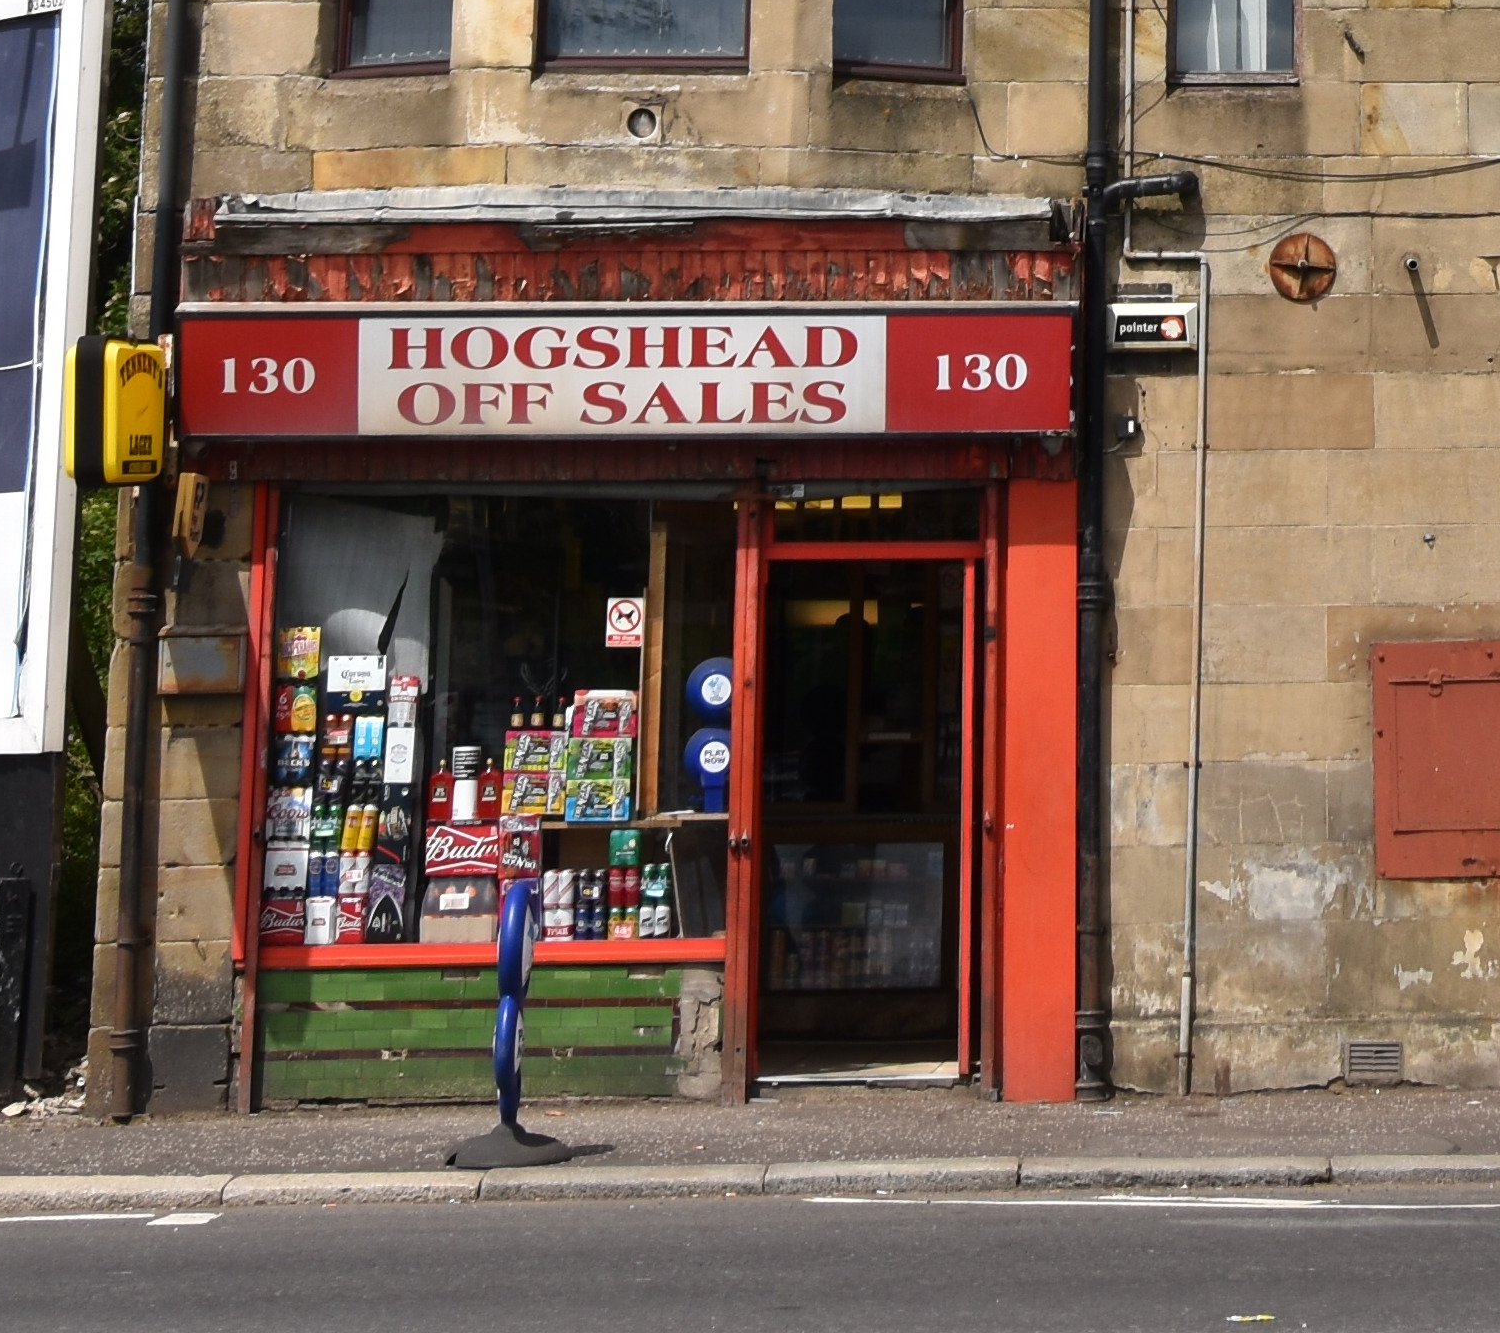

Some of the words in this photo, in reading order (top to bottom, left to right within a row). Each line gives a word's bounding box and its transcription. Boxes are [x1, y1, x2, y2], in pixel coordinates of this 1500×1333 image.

[386, 325, 859, 371] HOGSHEAD
[1119, 321, 1159, 336] pointer
[119, 351, 163, 390] TENNENT'S
[221, 356, 316, 395] 130
[935, 352, 1028, 391] 130
[396, 381, 554, 427] OFF
[579, 380, 848, 426] SALES
[129, 434, 153, 456] LAGER
[704, 749, 726, 757] PLAY
[704, 757, 726, 765] NOW
